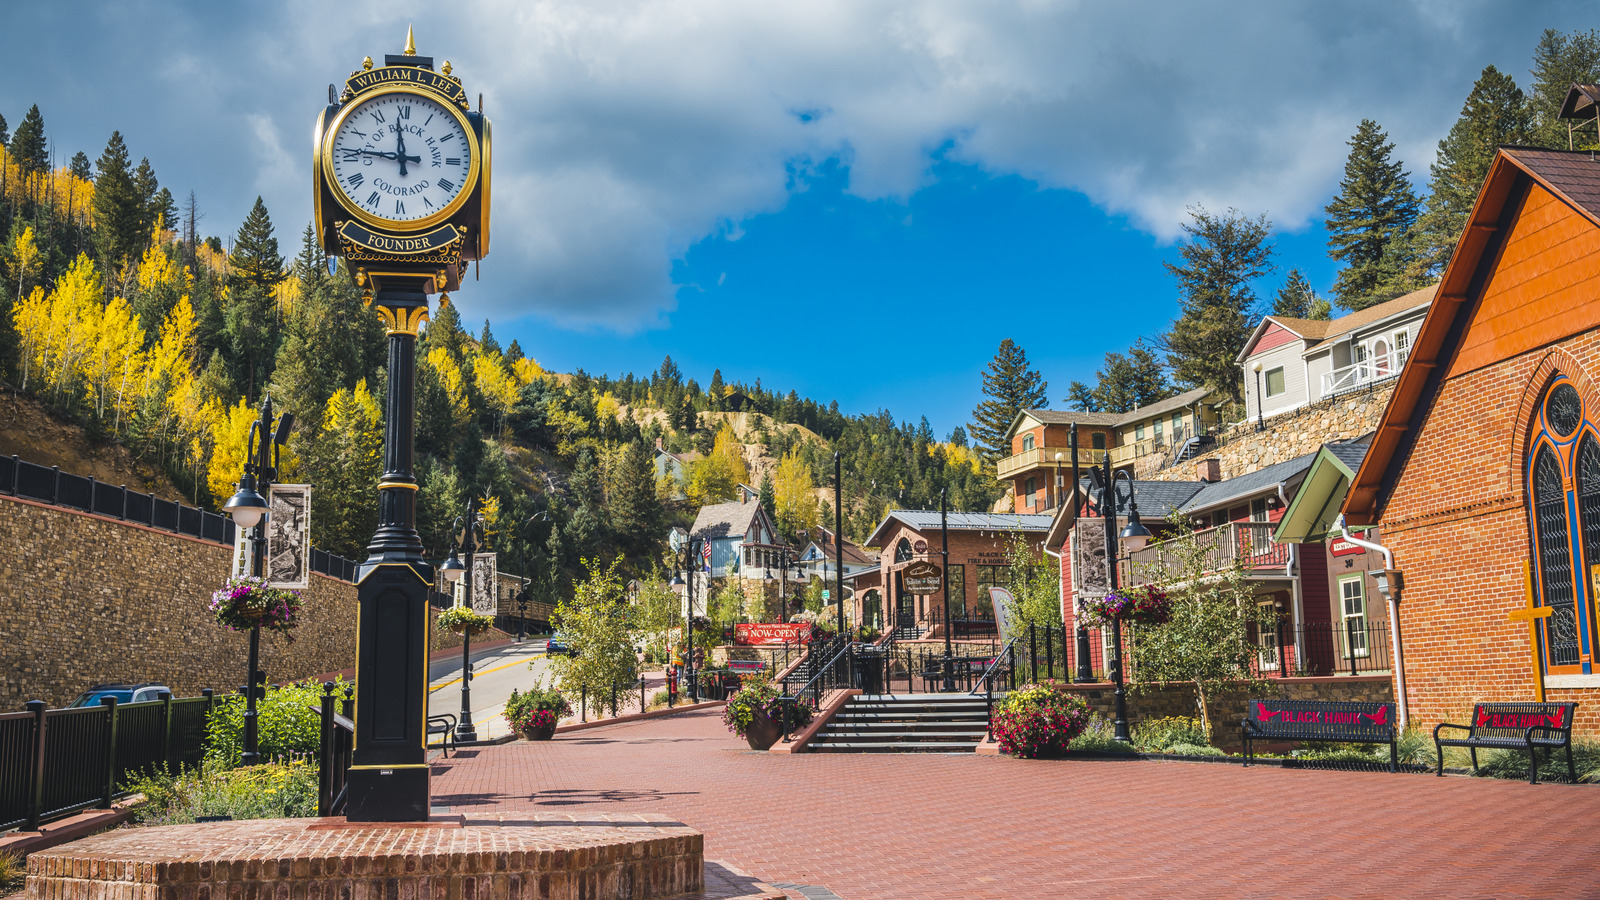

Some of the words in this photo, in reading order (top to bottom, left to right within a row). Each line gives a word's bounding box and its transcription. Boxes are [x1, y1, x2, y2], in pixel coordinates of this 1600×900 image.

[355, 69, 411, 88] WILLIAM
[416, 71, 426, 83] L.
[430, 76, 453, 93] LEE
[370, 109, 386, 126] XI
[396, 105, 411, 120] XII
[424, 113, 434, 126] I
[350, 127, 367, 140] X
[439, 132, 455, 143] II
[371, 128, 385, 142] OF
[424, 136, 442, 169] HAWK
[445, 157, 461, 166] III
[347, 172, 365, 191] VIII
[373, 177, 430, 196] COLORADO
[366, 190, 382, 209] VII
[395, 199, 406, 215] VI
[422, 195, 434, 210] V
[367, 234, 431, 250] FOUNDER
[1281, 710, 1320, 723] BLACK
[1324, 711, 1361, 724] HAWK
[1492, 714, 1519, 728] BLACK
[1520, 714, 1546, 728] HAWK
